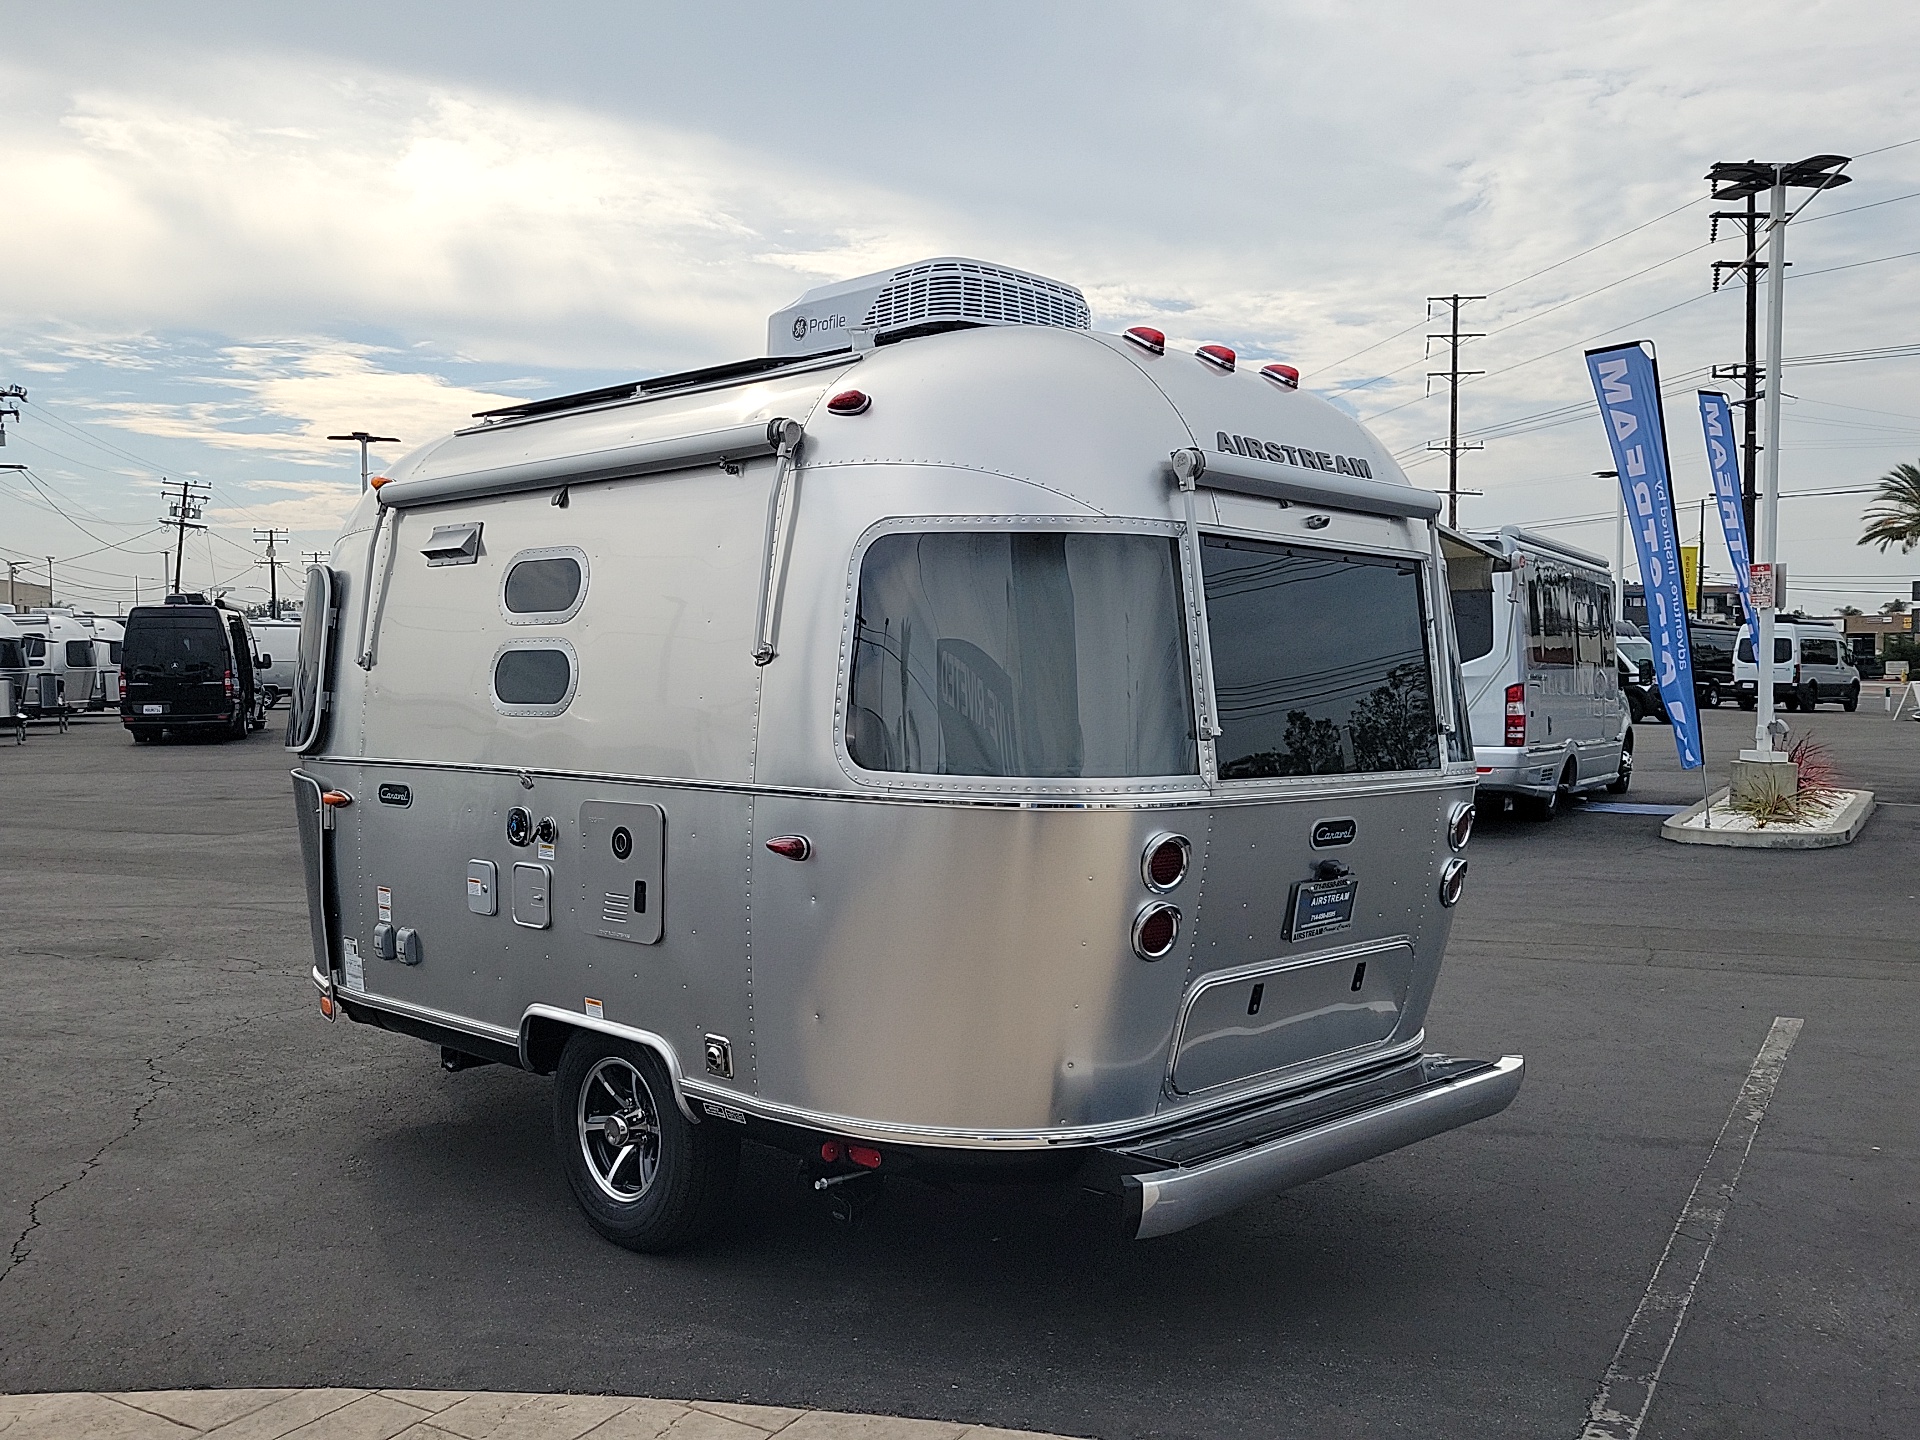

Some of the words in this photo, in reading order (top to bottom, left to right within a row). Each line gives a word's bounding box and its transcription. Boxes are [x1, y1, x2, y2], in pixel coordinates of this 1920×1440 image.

[809, 314, 846, 333] Profile
[1216, 431, 1373, 480] AIRSTREAM
[1316, 825, 1353, 841] Caravel
[1310, 892, 1351, 907] AIRSTREAM
[1293, 928, 1324, 942] AIRSTREAM
